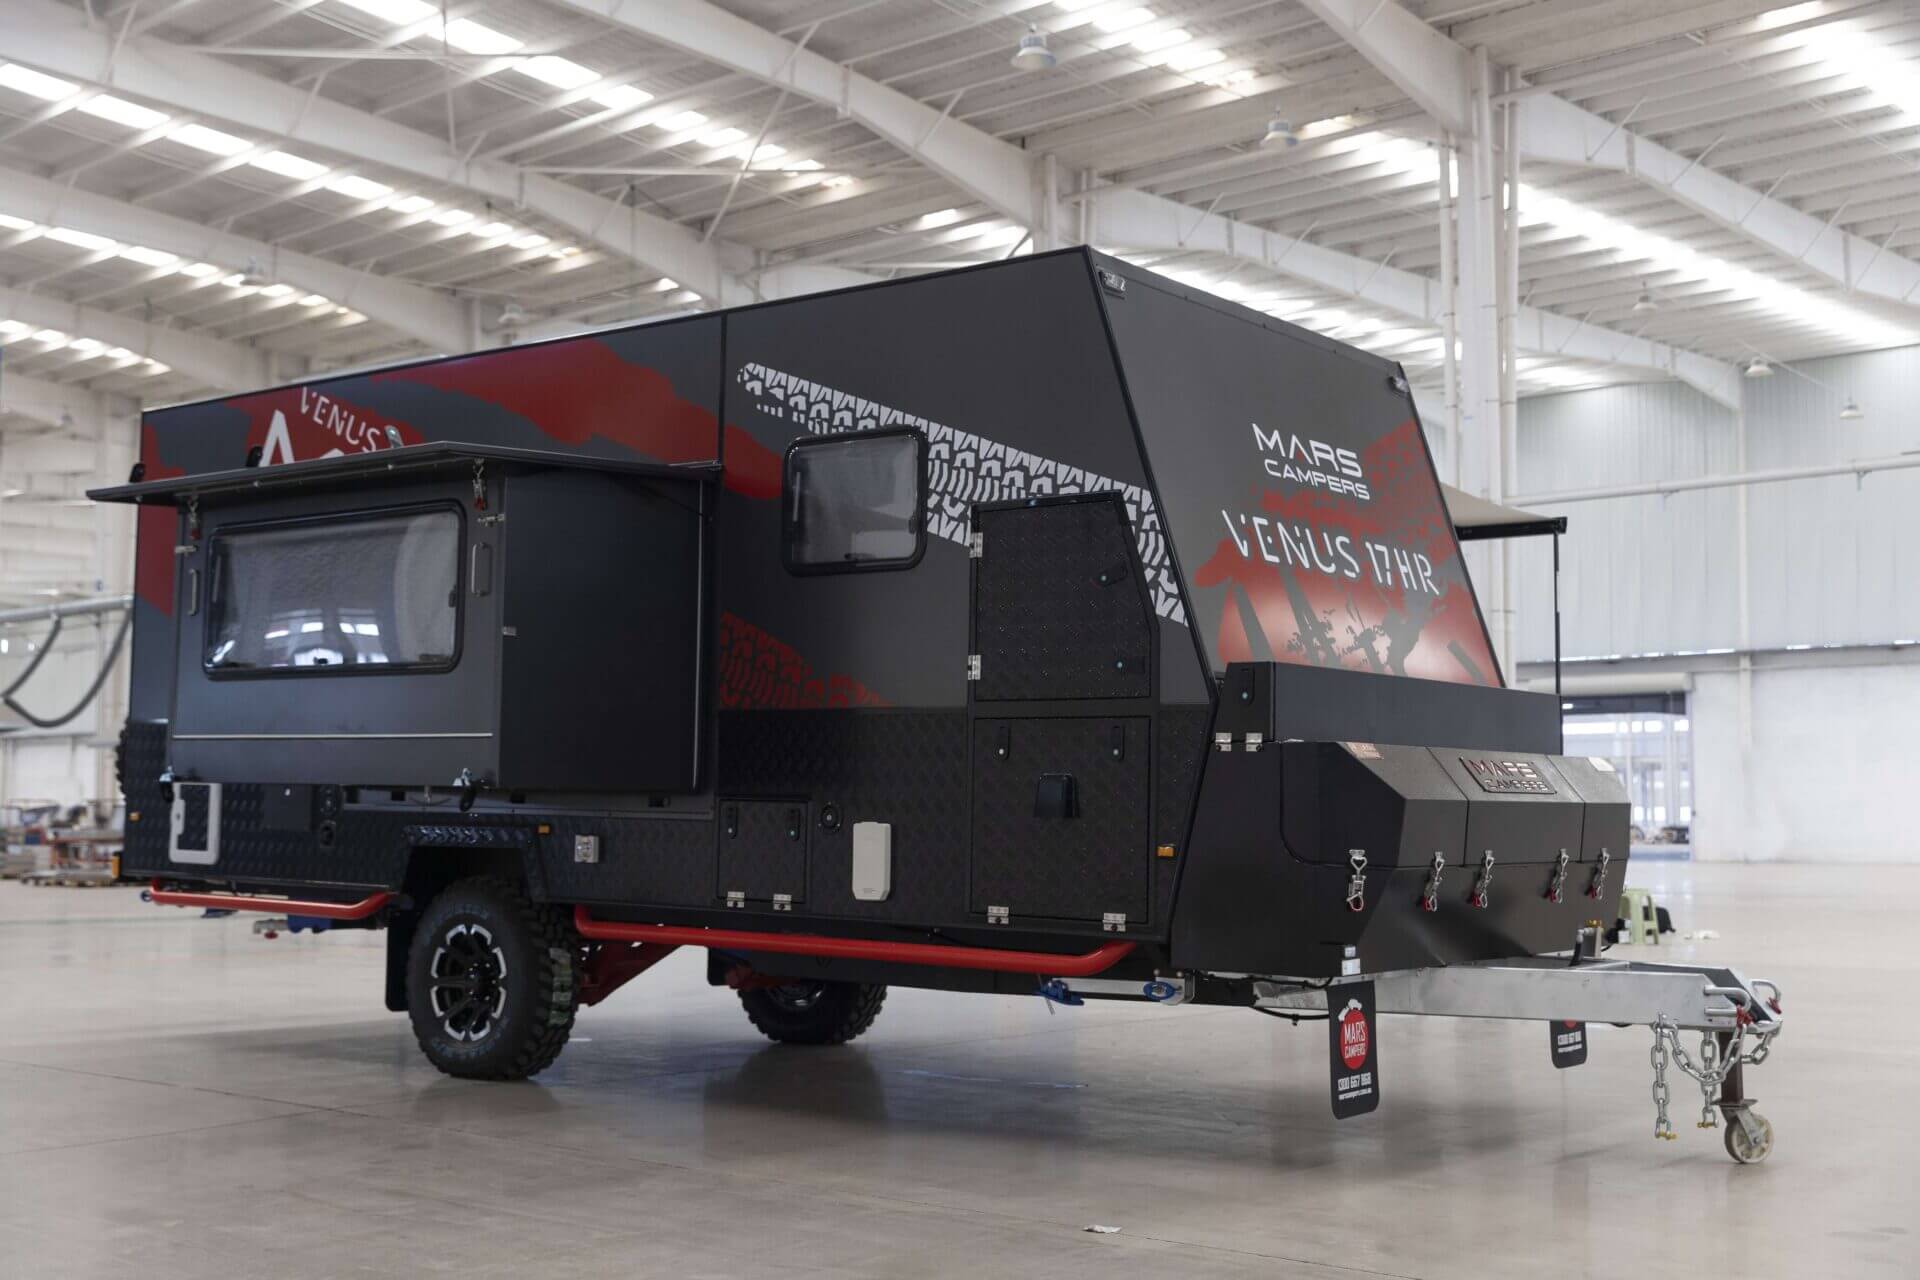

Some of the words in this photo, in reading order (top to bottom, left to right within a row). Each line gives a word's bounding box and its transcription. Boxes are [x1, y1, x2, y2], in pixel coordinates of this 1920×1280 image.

[301, 386, 381, 453] VENUS
[1252, 423, 1363, 478] MARS
[1264, 459, 1370, 500] CAMPERS
[1222, 510, 1361, 578] VENUS
[1365, 541, 1440, 596] 17HR
[1344, 1021, 1366, 1044] MARS
